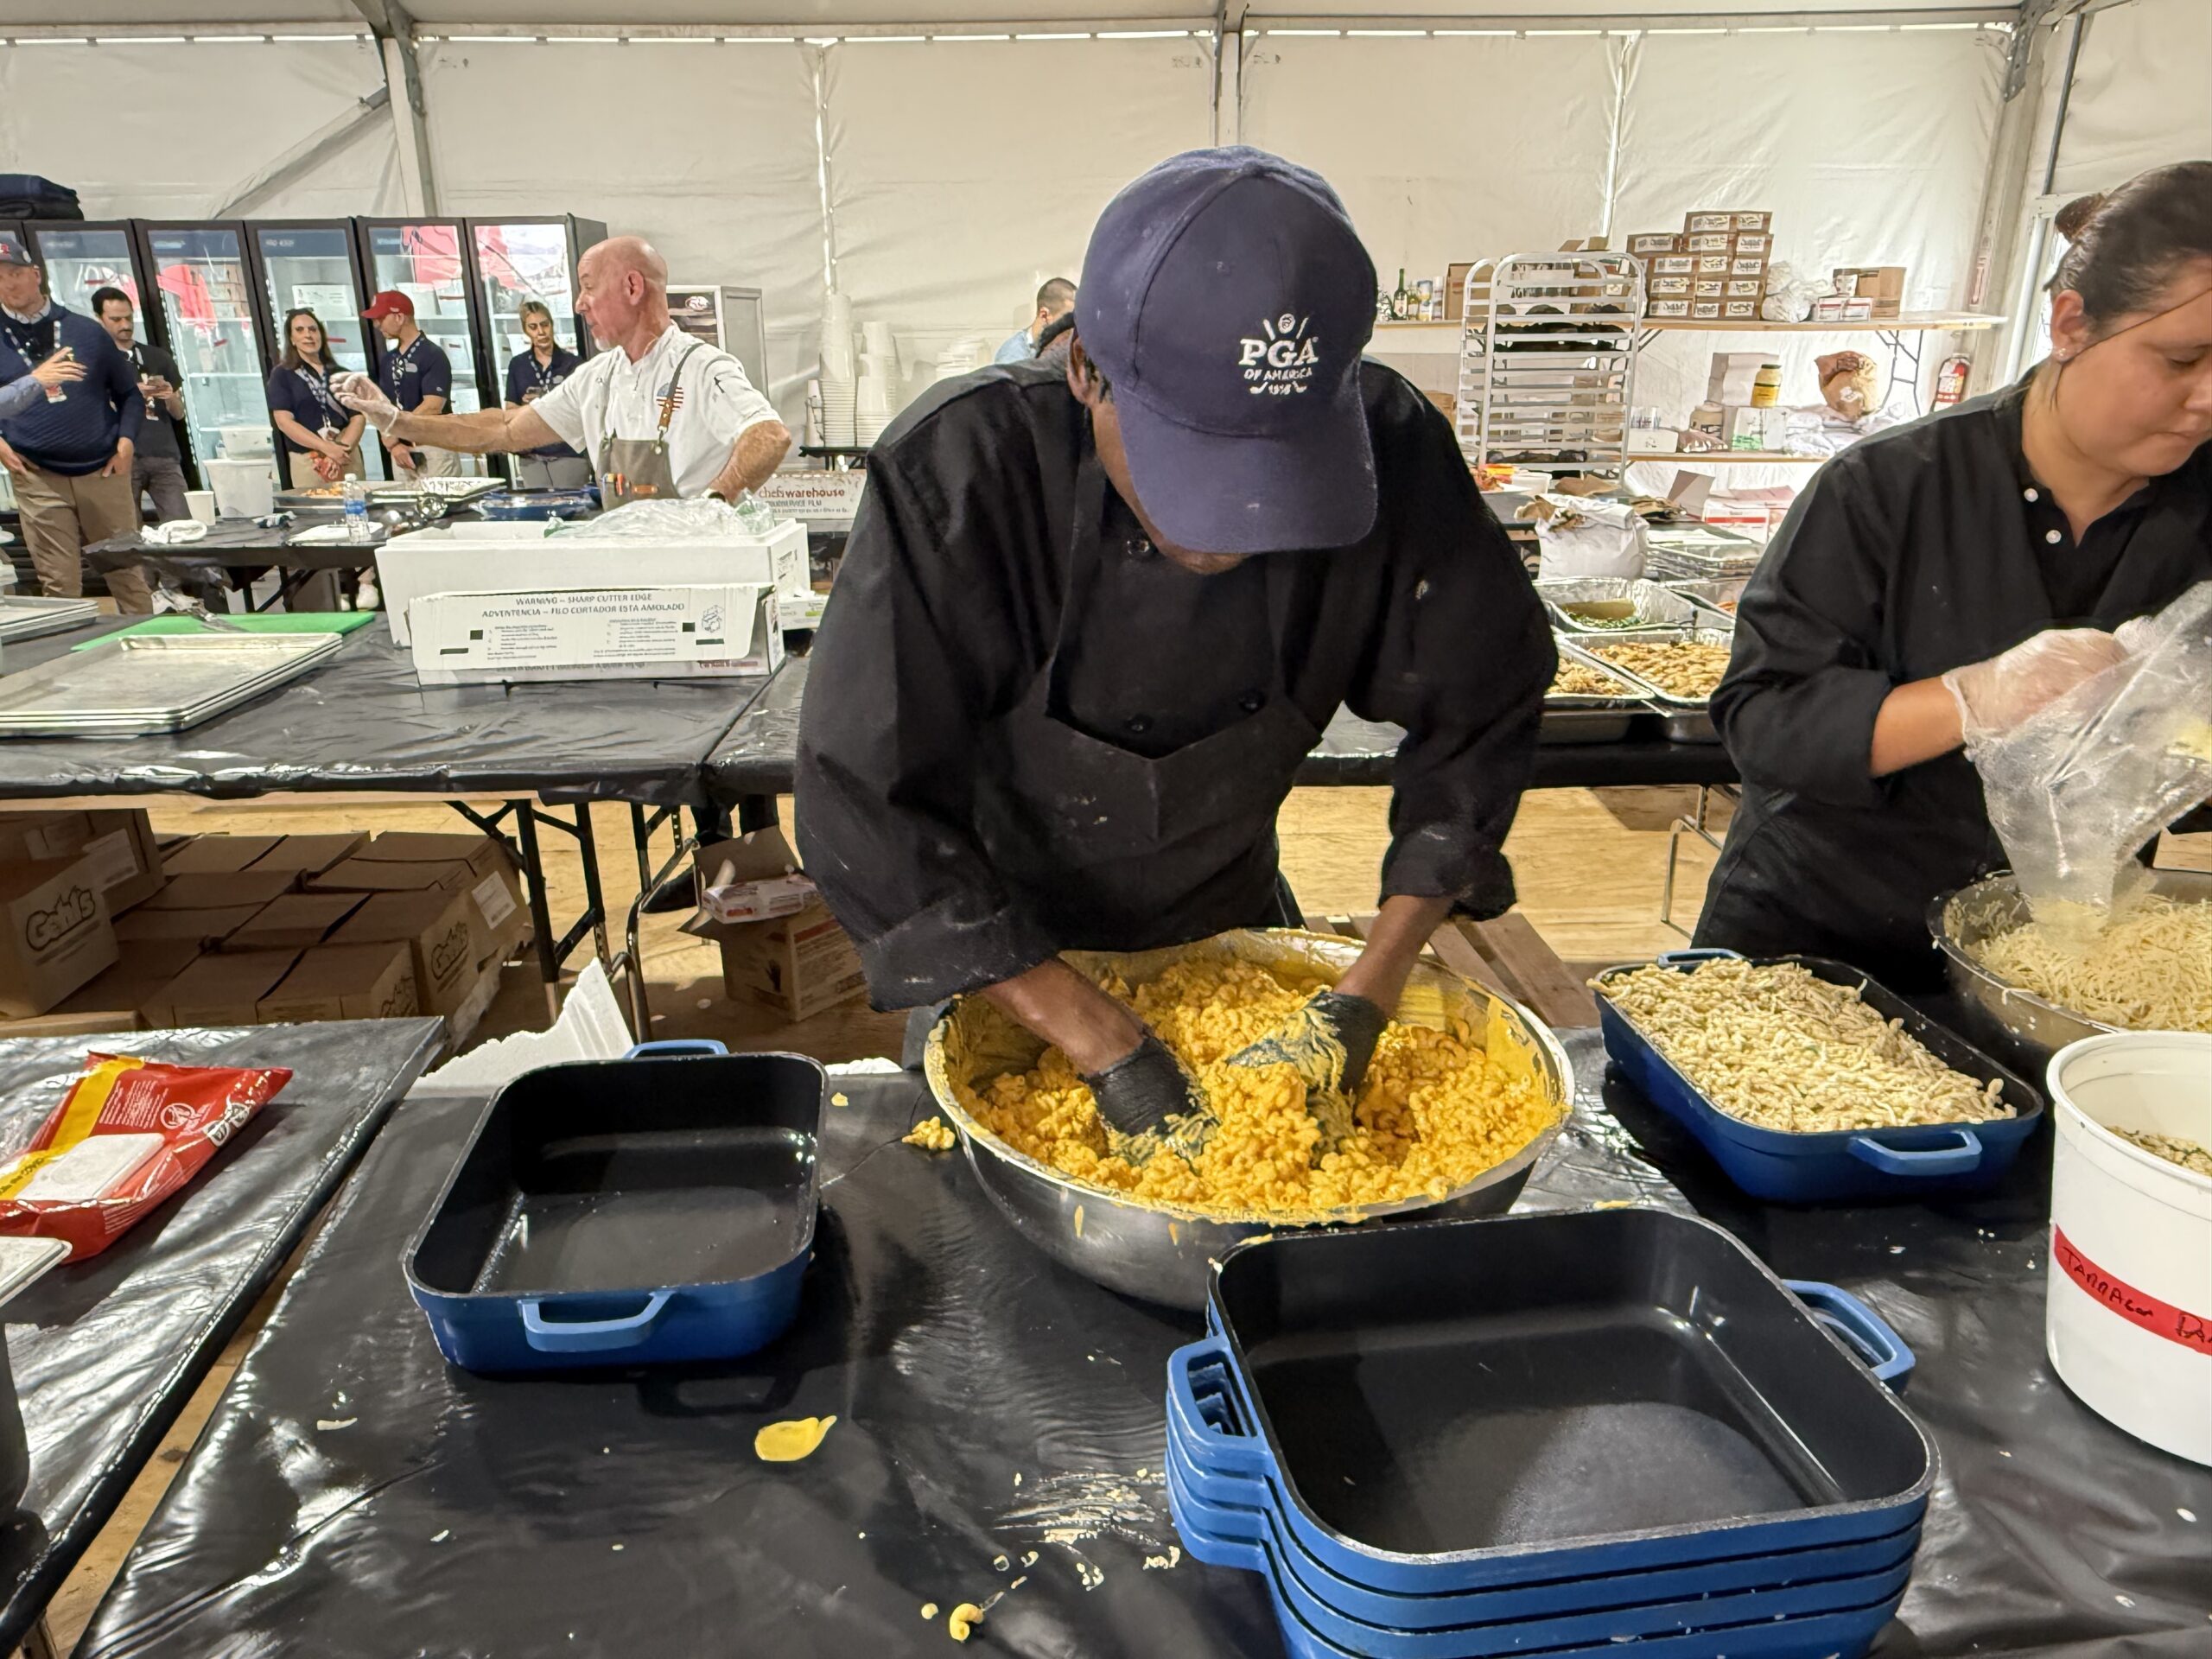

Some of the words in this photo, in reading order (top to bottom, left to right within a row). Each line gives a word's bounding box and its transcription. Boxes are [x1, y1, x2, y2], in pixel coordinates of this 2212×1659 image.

[1238, 338, 1319, 368] PGA
[1244, 368, 1262, 380] OF
[1263, 367, 1313, 380] AMERICA
[516, 596, 557, 606] WARNING
[631, 593, 652, 601] EDGE
[570, 606, 617, 614] CORTADOR
[641, 603, 684, 612] AMOLADO
